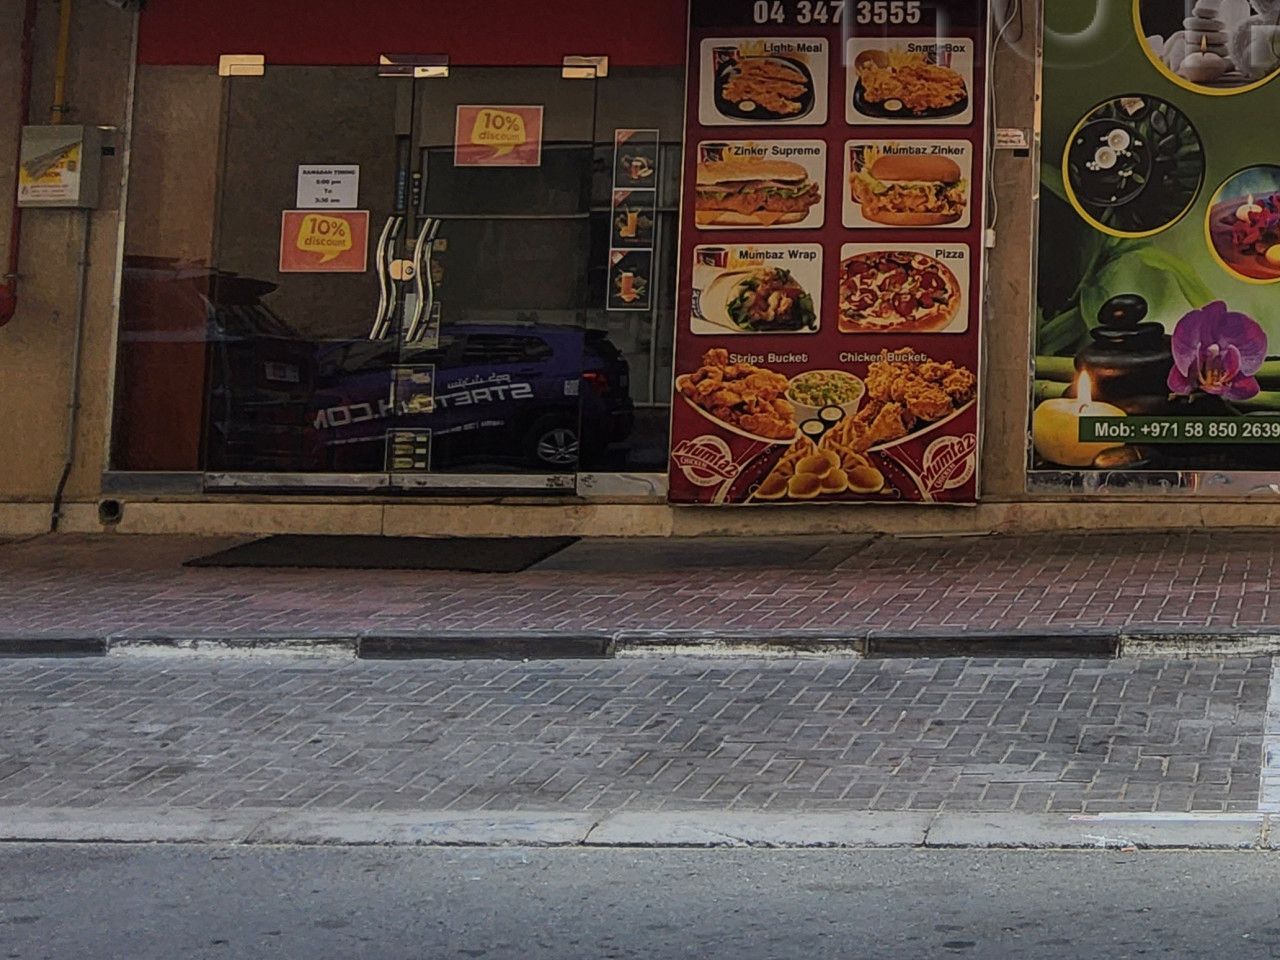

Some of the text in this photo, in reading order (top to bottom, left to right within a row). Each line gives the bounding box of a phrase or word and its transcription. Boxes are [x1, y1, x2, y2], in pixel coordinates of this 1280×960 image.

[753, 1, 921, 24] 04 347 3555
[763, 42, 823, 54] Light Meal
[944, 42, 966, 53] Box
[484, 111, 520, 131] 10%
[733, 145, 821, 158] Zinker Supreme
[882, 145, 965, 156] Mumtaz Zinker
[309, 217, 346, 237] 10%
[304, 235, 346, 247] discount
[738, 249, 817, 262] Mumtaz Wrap
[935, 248, 965, 260] Pizza
[729, 352, 809, 364] Strips Bucket
[839, 351, 928, 363] Chicken Bucket
[1094, 422, 1280, 437] Mob: +971 58 850 2639
